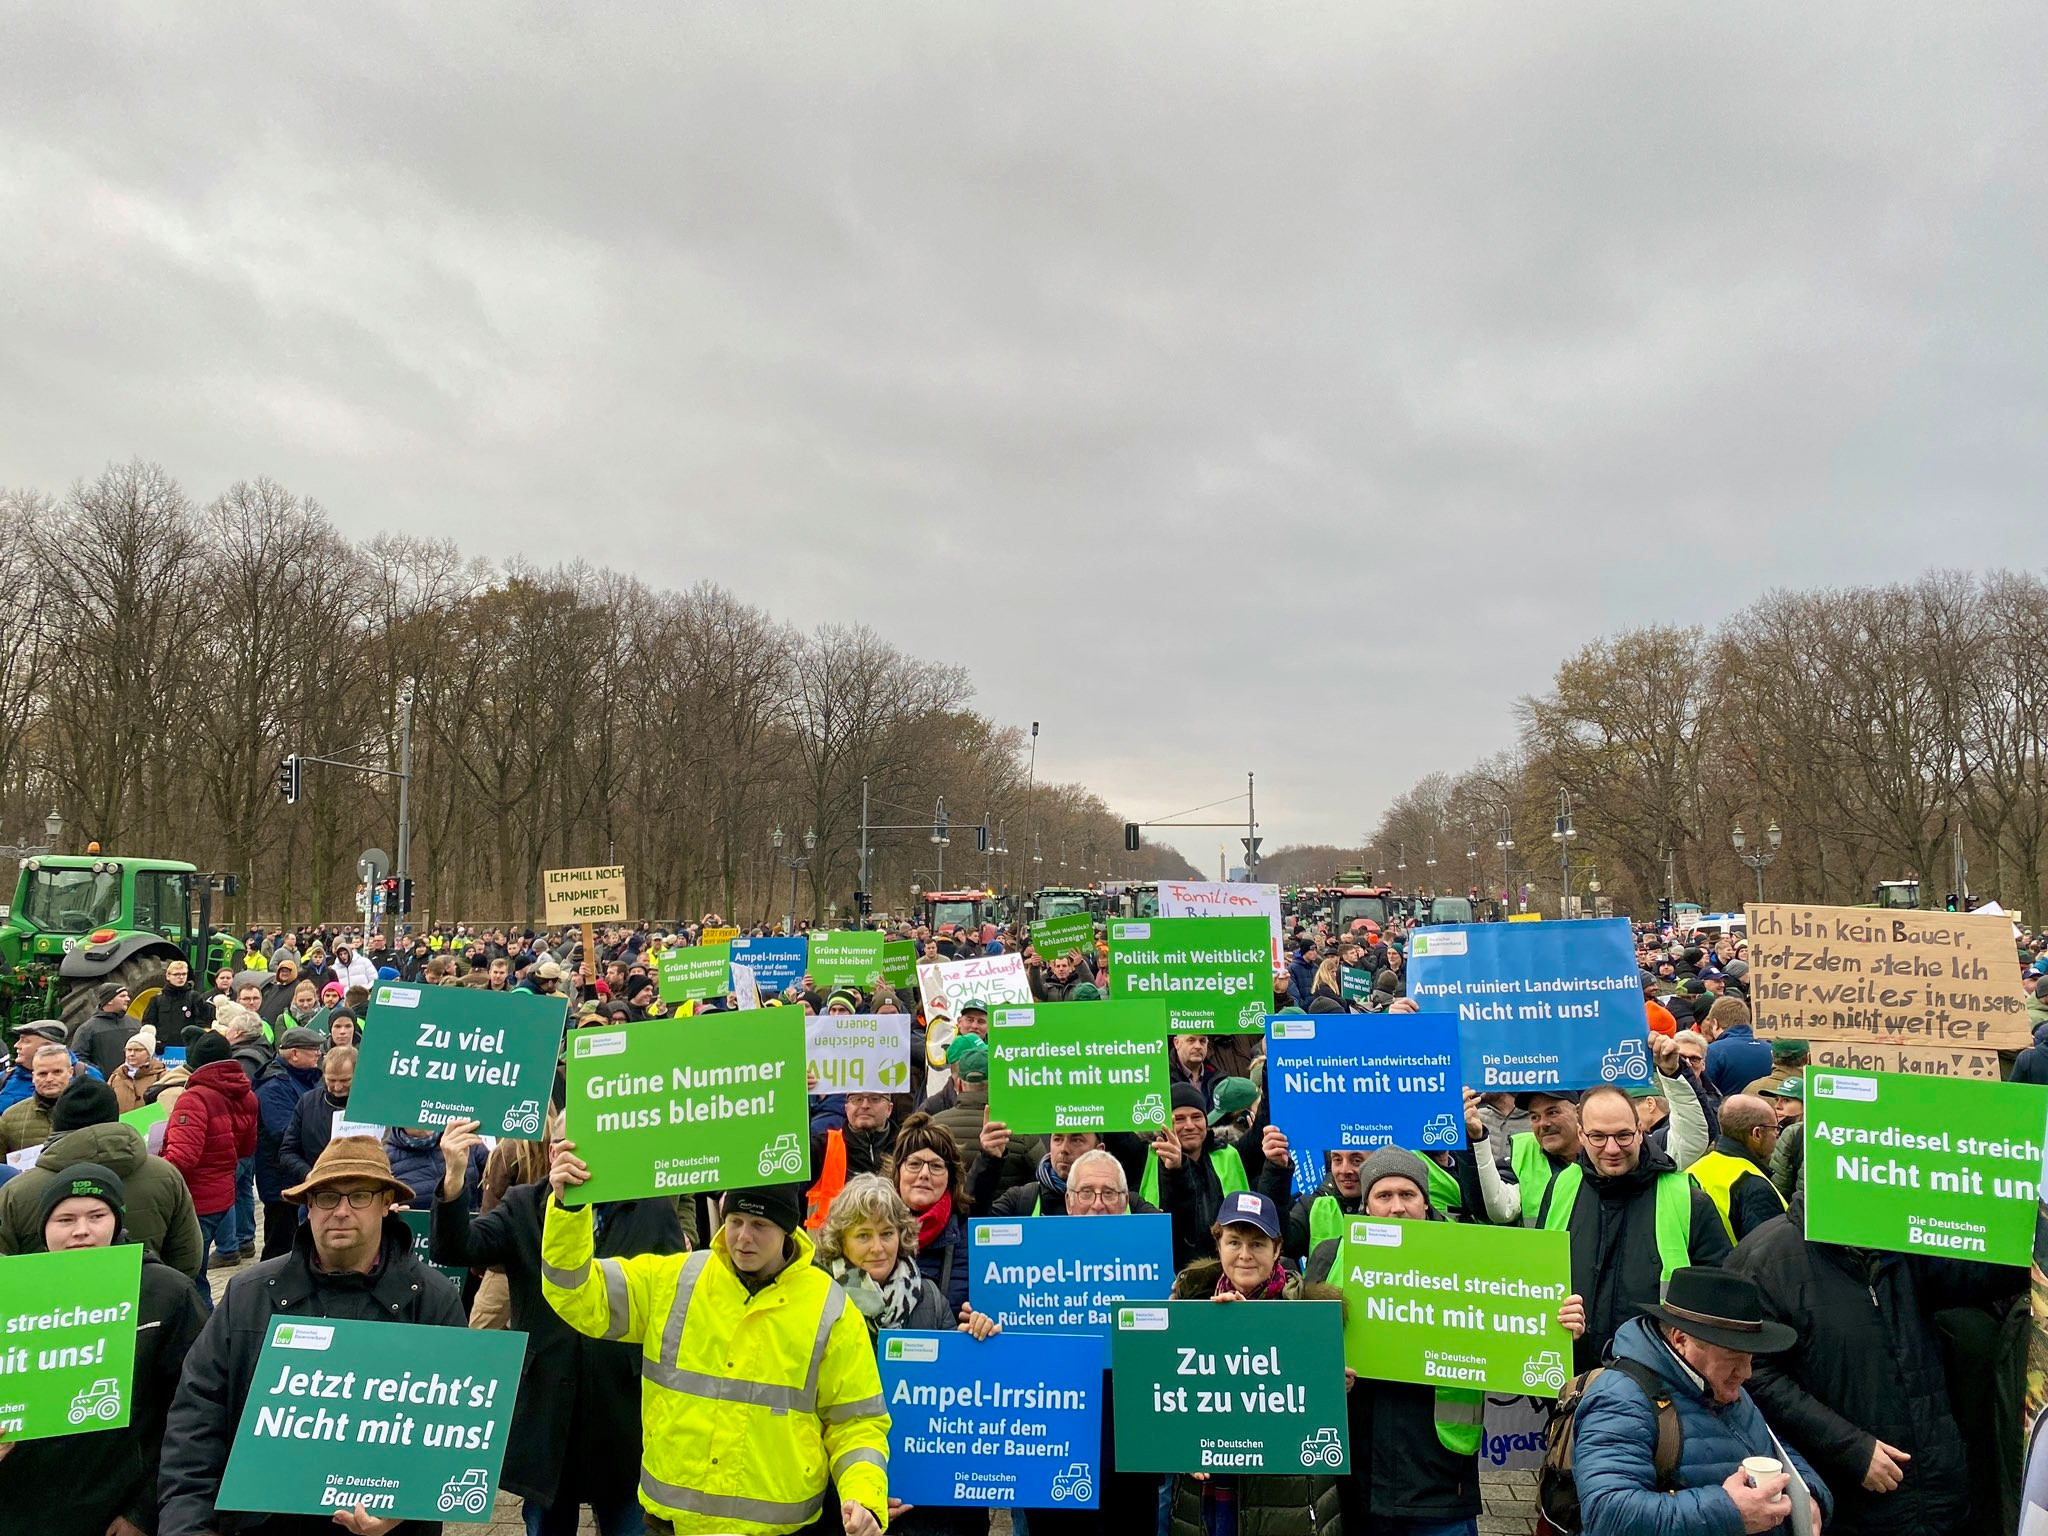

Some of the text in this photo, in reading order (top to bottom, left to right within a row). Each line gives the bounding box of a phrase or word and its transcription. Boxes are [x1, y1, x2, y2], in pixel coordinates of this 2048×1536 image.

[550, 868, 624, 883] ICH WILL NOCH
[549, 889, 608, 902] LANDWIRT
[574, 904, 619, 916] WERDEN
[1040, 933, 1087, 946] Fehlanzeige!
[1751, 910, 1972, 950] Ich bin kein Bauer,
[64, 941, 74, 950] 50
[815, 947, 877, 955] Grüne Nummer
[664, 959, 726, 972] Grüne Nummer
[735, 952, 801, 963] Ampel-Irrsinn:
[840, 957, 873, 965] bleiben!
[1115, 950, 1265, 964] Politik mit Weitblick?
[1751, 944, 1988, 980] trotzdem stehe Ich
[668, 968, 722, 982] muss bleiben!
[964, 957, 1022, 978] Zukunft
[946, 978, 1006, 998] OHNE
[1127, 972, 1254, 994] Fehlanzeige!
[1414, 975, 1638, 997] Ampel ruiniert Landwirtschaft!
[1880, 989, 1918, 1007] es
[1926, 983, 1945, 1008] in
[1951, 992, 2026, 1014] unserem
[1459, 1000, 1600, 1021] Nicht mit uns!
[836, 1020, 877, 1031] Bauern
[1171, 1018, 1214, 1029] Bauern
[1756, 1001, 1990, 1041] Land so nicht weiter
[416, 1023, 505, 1054] Zu viel
[815, 1036, 898, 1048] Die Badischen
[994, 1040, 1163, 1061] Agrardiesel streichen?
[1483, 1054, 1558, 1064] Die Deutschen
[389, 1051, 521, 1087] ist zu viel!
[1277, 1055, 1451, 1069] Ampel ruiniert Landwirtschaft!
[586, 1060, 785, 1100] Grüne Nummer
[1008, 1065, 1150, 1087] Nicht mit uns!
[1285, 1071, 1445, 1093] Nicht mit uns!
[1485, 1068, 1559, 1086] Bauern
[421, 1100, 474, 1113] Die Deutschen
[596, 1090, 775, 1132] muss bleiben!
[1056, 1114, 1104, 1126] Bauern
[1342, 1133, 1393, 1145] Bauern
[1814, 1121, 2044, 1161] Agrardiesel streich
[655, 1155, 720, 1170] Die Deutschen
[655, 1169, 720, 1189] Bauern
[1836, 1155, 2040, 1200] Nicht mit un
[72, 1187, 103, 1195] agrar
[1909, 1215, 1986, 1233] Die Deutschen
[1909, 1227, 1986, 1251] Bauern
[984, 1257, 1159, 1289] Ampel-Irrsinn:
[1350, 1265, 1565, 1301] Agrardiesel streichen?
[1019, 1292, 1088, 1308] Nicht auf
[6, 1302, 131, 1333] streichen?
[999, 1311, 1054, 1326] Rücken
[1058, 1311, 1084, 1325] der
[1367, 1297, 1547, 1336] Nicht mit uns!
[38, 1338, 105, 1370] uns!
[1176, 1346, 1281, 1376] Zu viel
[1425, 1350, 1487, 1364] Die Deutschen
[1425, 1361, 1486, 1382] Bauern
[270, 1365, 355, 1399] Jetzt
[891, 1379, 1086, 1413] Ampel-Irrsinn:
[1153, 1383, 1306, 1413] ist zu viel!
[253, 1406, 495, 1450] Nicht mit uns!
[929, 1418, 1047, 1437] Nicht auf dem
[904, 1437, 1070, 1457] Rücken der Bauern!
[1200, 1439, 1263, 1448] Die Deutschen
[1201, 1450, 1264, 1467] Bauern
[326, 1475, 399, 1488] Die Deutschen
[955, 1472, 1016, 1482] Die Deutschen
[320, 1488, 395, 1510] Bauern
[954, 1483, 1015, 1500] Bauern
